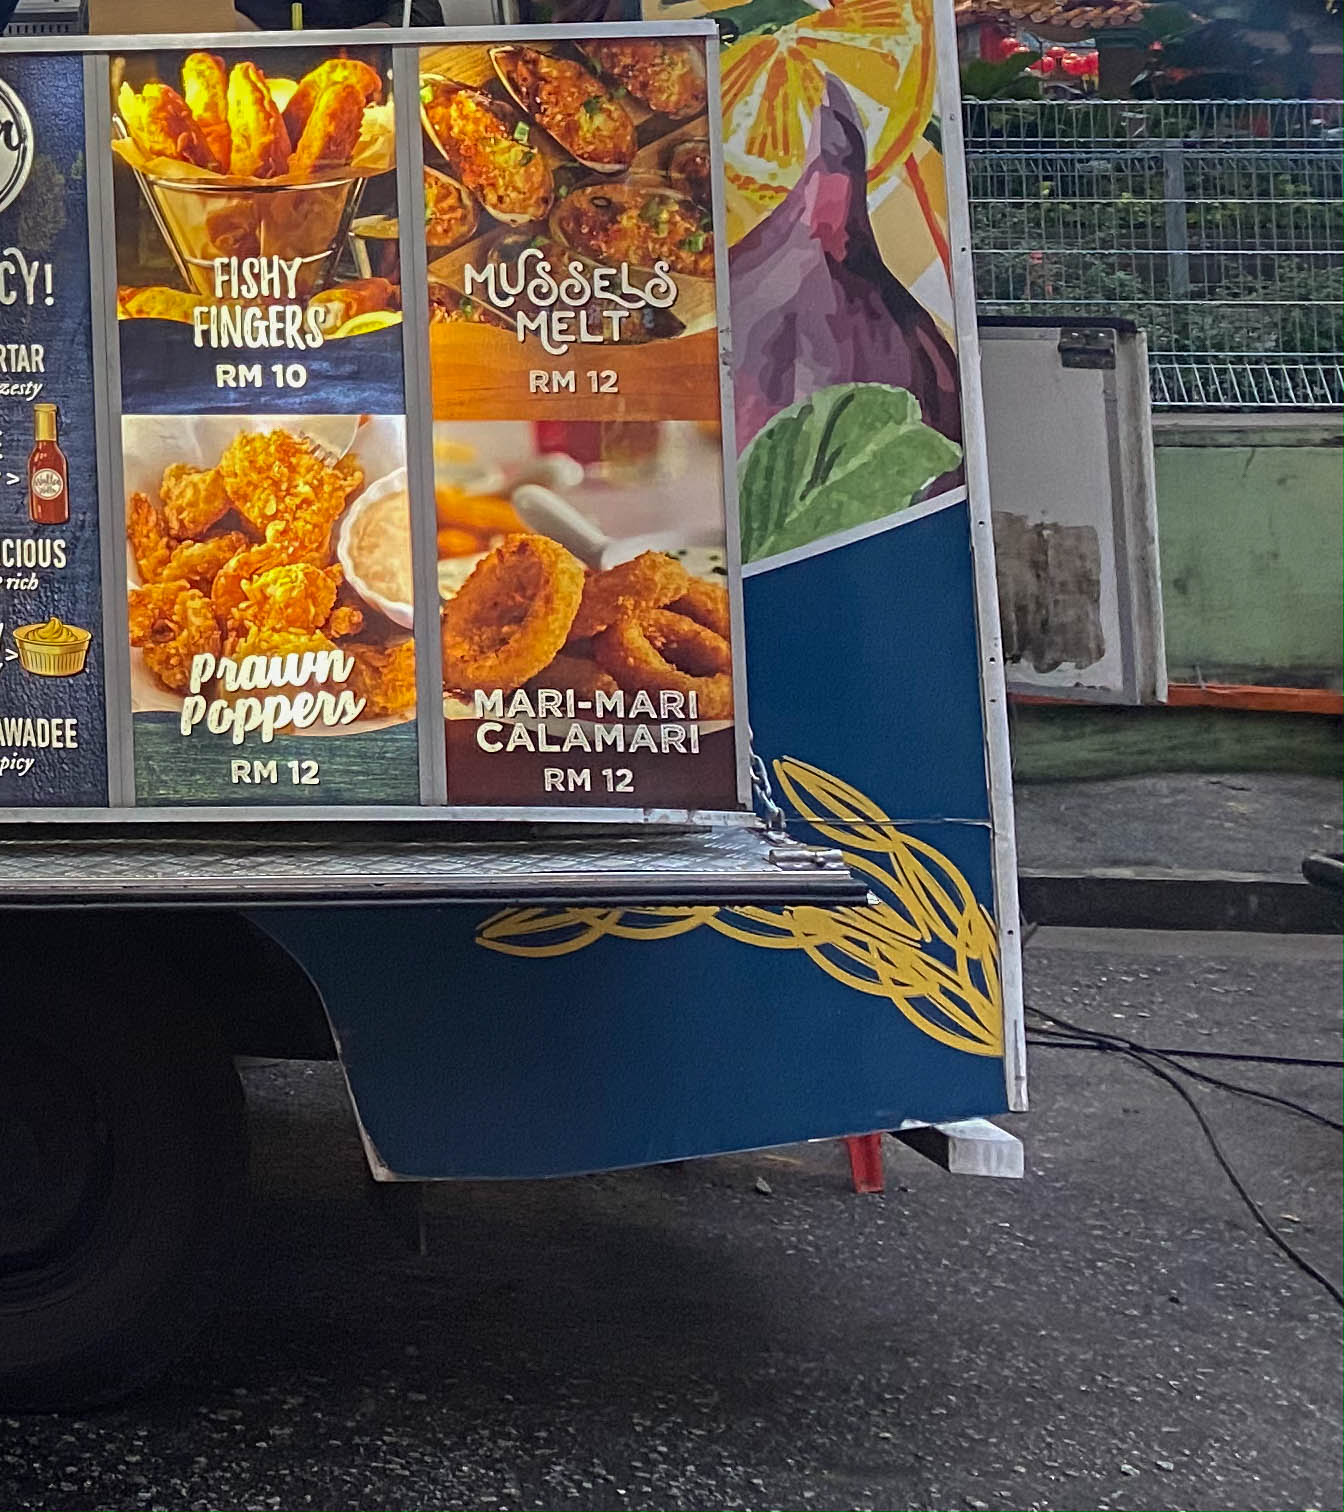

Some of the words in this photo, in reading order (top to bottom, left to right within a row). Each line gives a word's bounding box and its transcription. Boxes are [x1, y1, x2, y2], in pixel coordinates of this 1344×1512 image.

[214, 255, 303, 299] FISHY
[464, 248, 678, 309] MUSSELS
[193, 305, 326, 350] FINGERS
[516, 310, 630, 355] MELT
[216, 364, 262, 388] RM
[271, 364, 307, 388] 10
[529, 370, 576, 393] RM
[587, 370, 619, 393] 12
[4, 571, 39, 591] rich
[190, 649, 355, 694] Prawn
[180, 690, 367, 745] Poppers
[474, 688, 699, 719] MARI-MARI
[476, 722, 700, 753] CALAMARI
[230, 759, 278, 784] RM
[287, 760, 320, 785] 12
[544, 768, 592, 792] RM
[602, 768, 634, 792] 12
